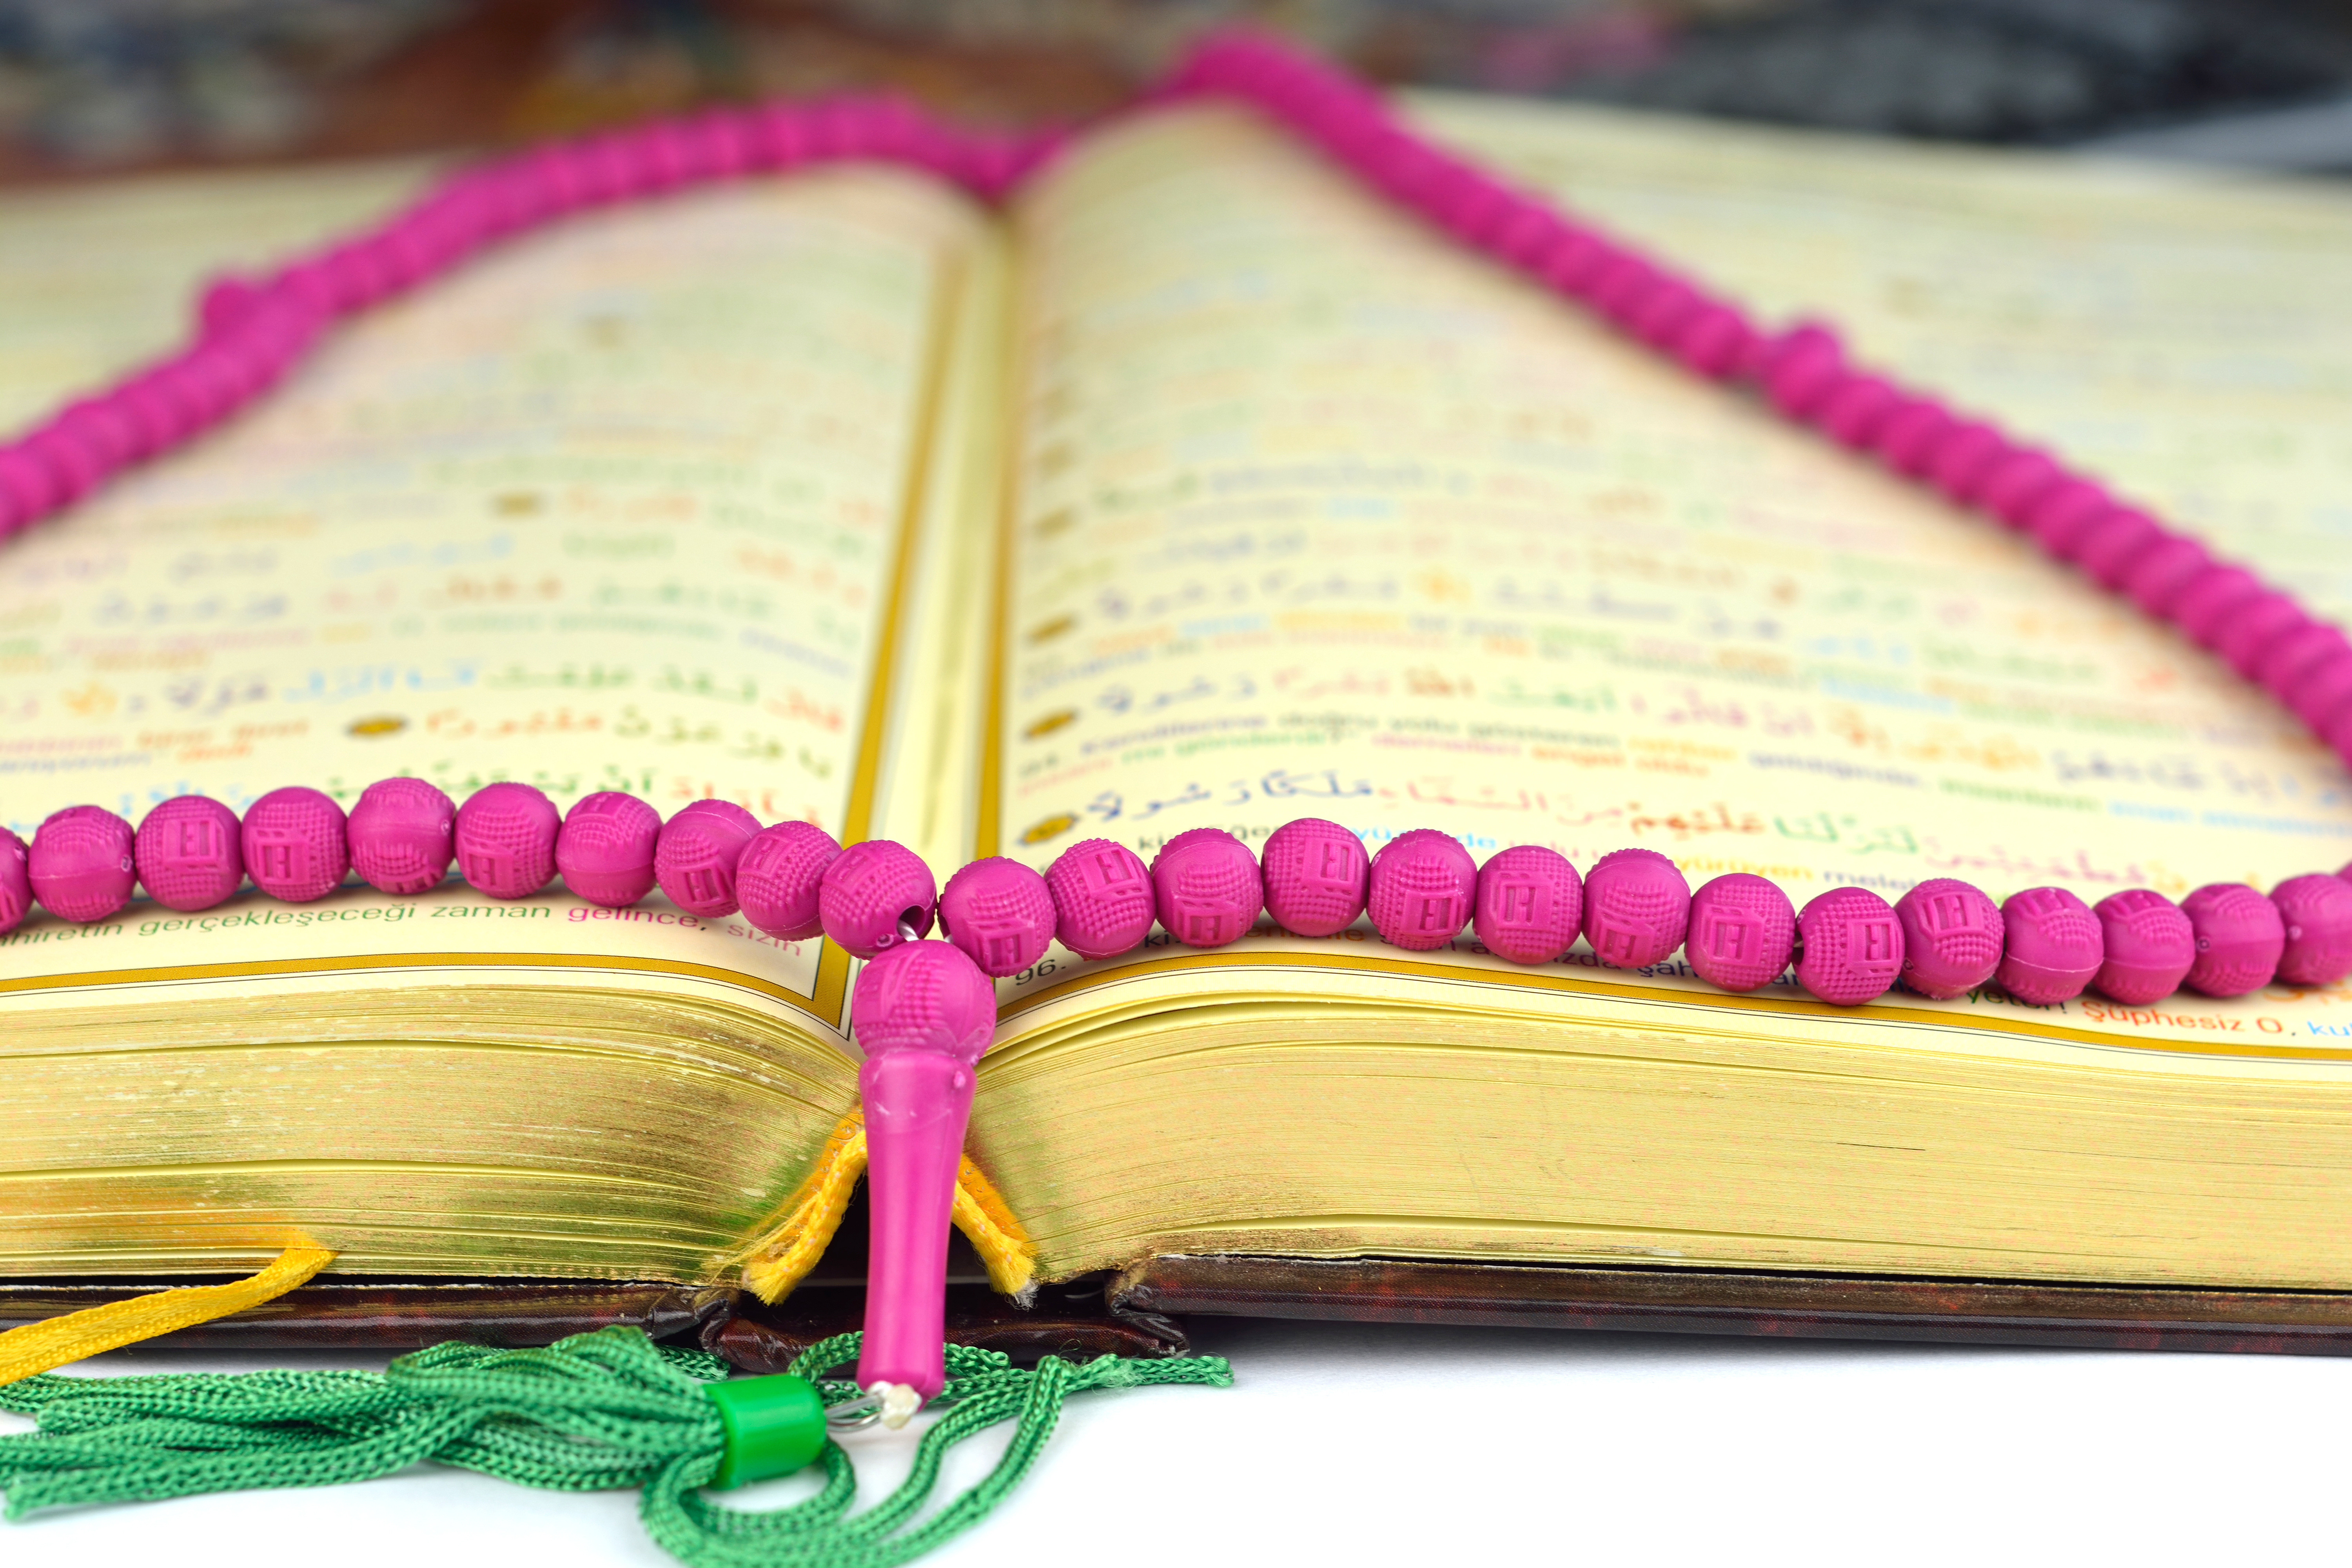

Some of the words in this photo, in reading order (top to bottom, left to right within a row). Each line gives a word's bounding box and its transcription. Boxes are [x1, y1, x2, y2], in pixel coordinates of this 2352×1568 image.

[139, 903, 416, 936] gerçekleşeceği
[431, 905, 551, 918] zaman
[568, 906, 707, 931] gelince,
[1015, 959, 1066, 986] 96.
